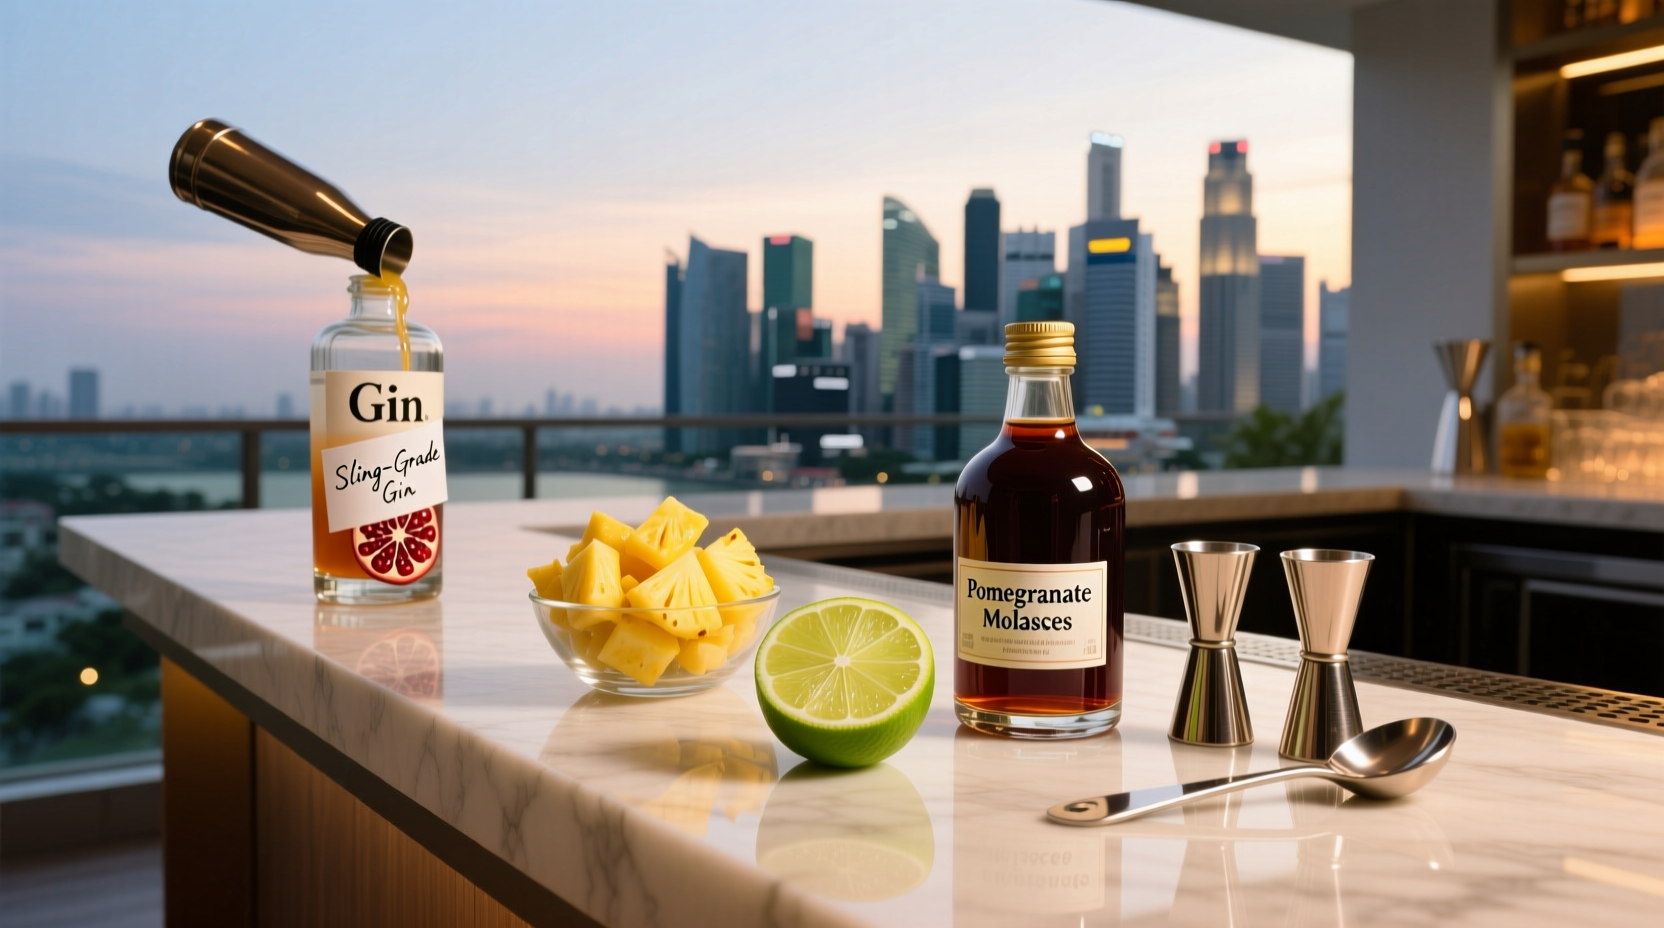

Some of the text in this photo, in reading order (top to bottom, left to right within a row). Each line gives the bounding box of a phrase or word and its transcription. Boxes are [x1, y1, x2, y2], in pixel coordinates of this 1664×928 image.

[349, 382, 423, 422] Gin
[335, 440, 440, 492] Sling-Grade
[382, 479, 416, 504] Gin
[967, 578, 1091, 608] Pomegranate
[982, 607, 1072, 631] Molasces
